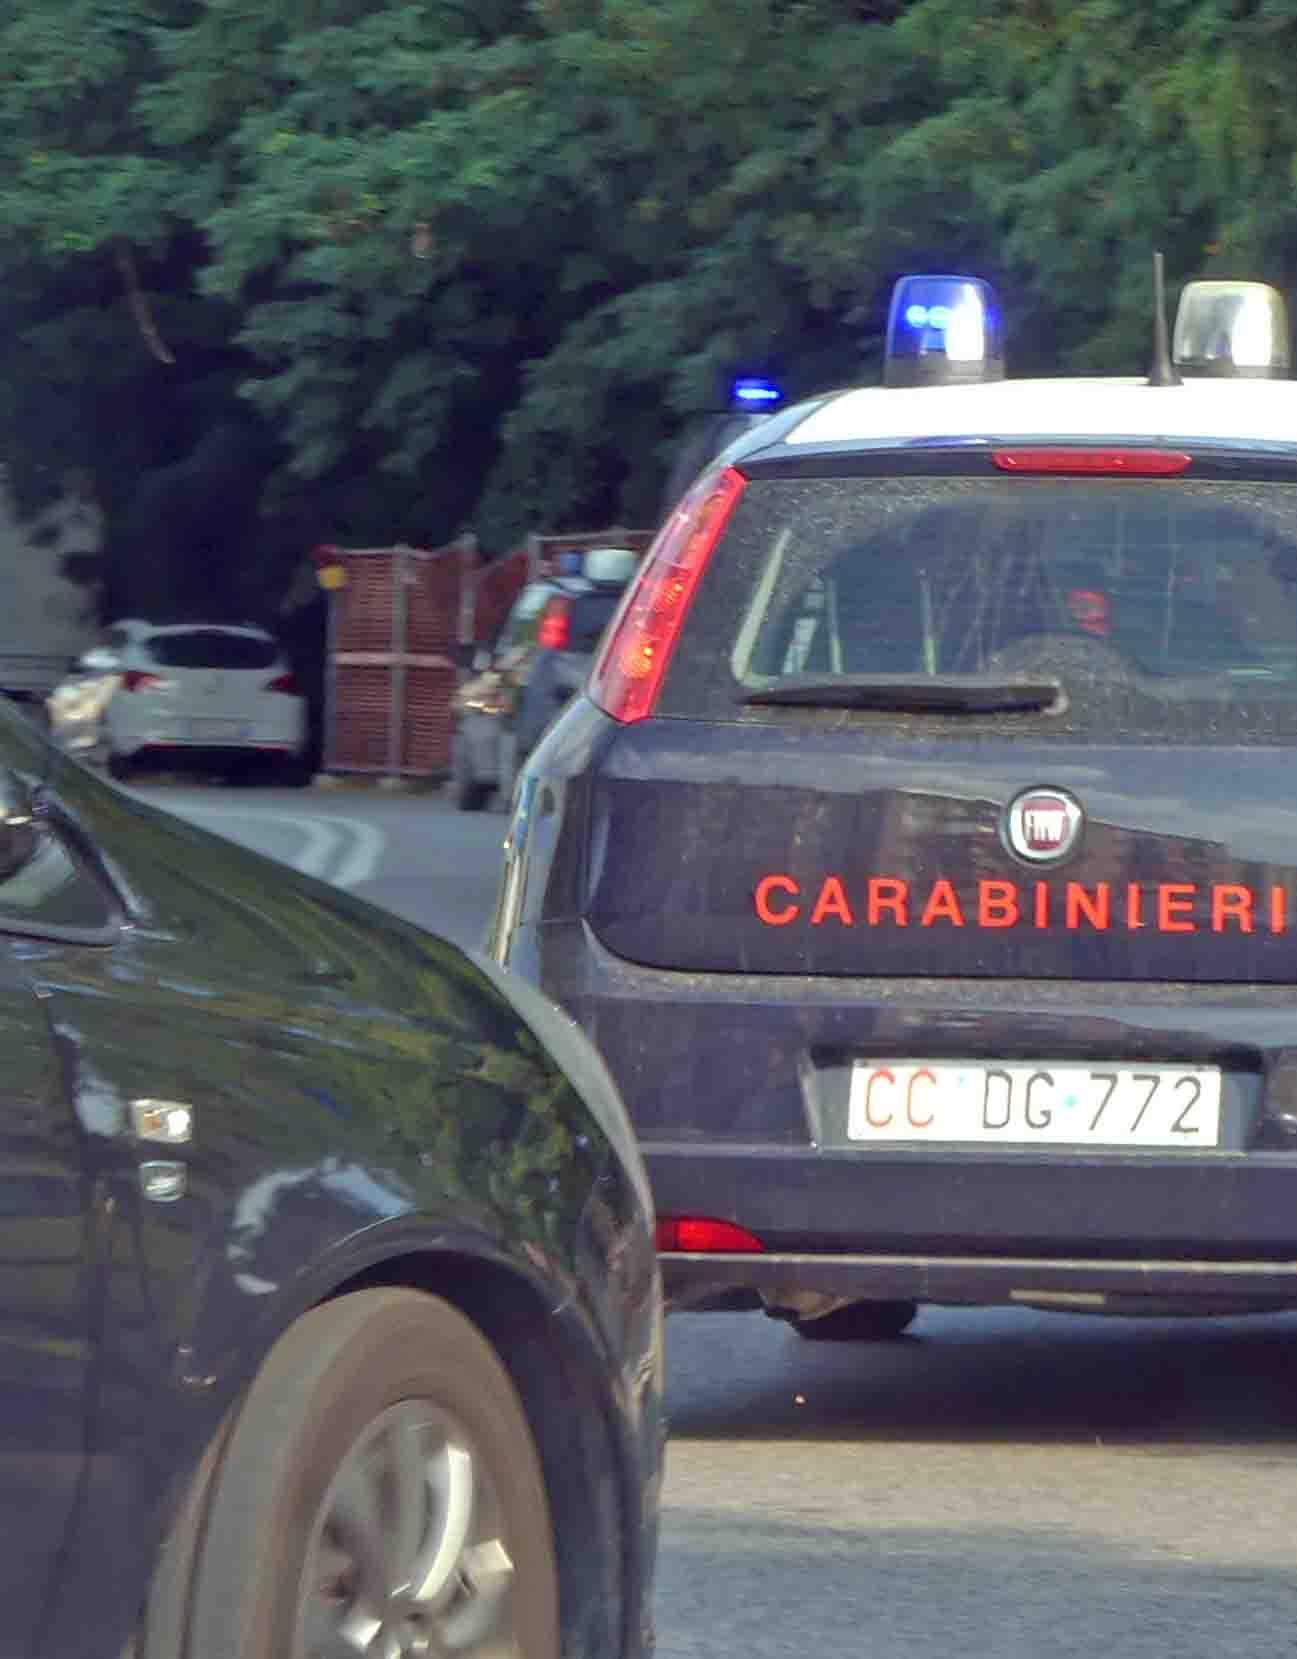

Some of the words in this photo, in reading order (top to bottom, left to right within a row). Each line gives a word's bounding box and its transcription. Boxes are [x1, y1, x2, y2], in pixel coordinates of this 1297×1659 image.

[754, 875, 1286, 933] CARABINIERI
[864, 1067, 937, 1129] CC
[982, 1069, 1055, 1130] DG
[1088, 1072, 1202, 1134] 772
